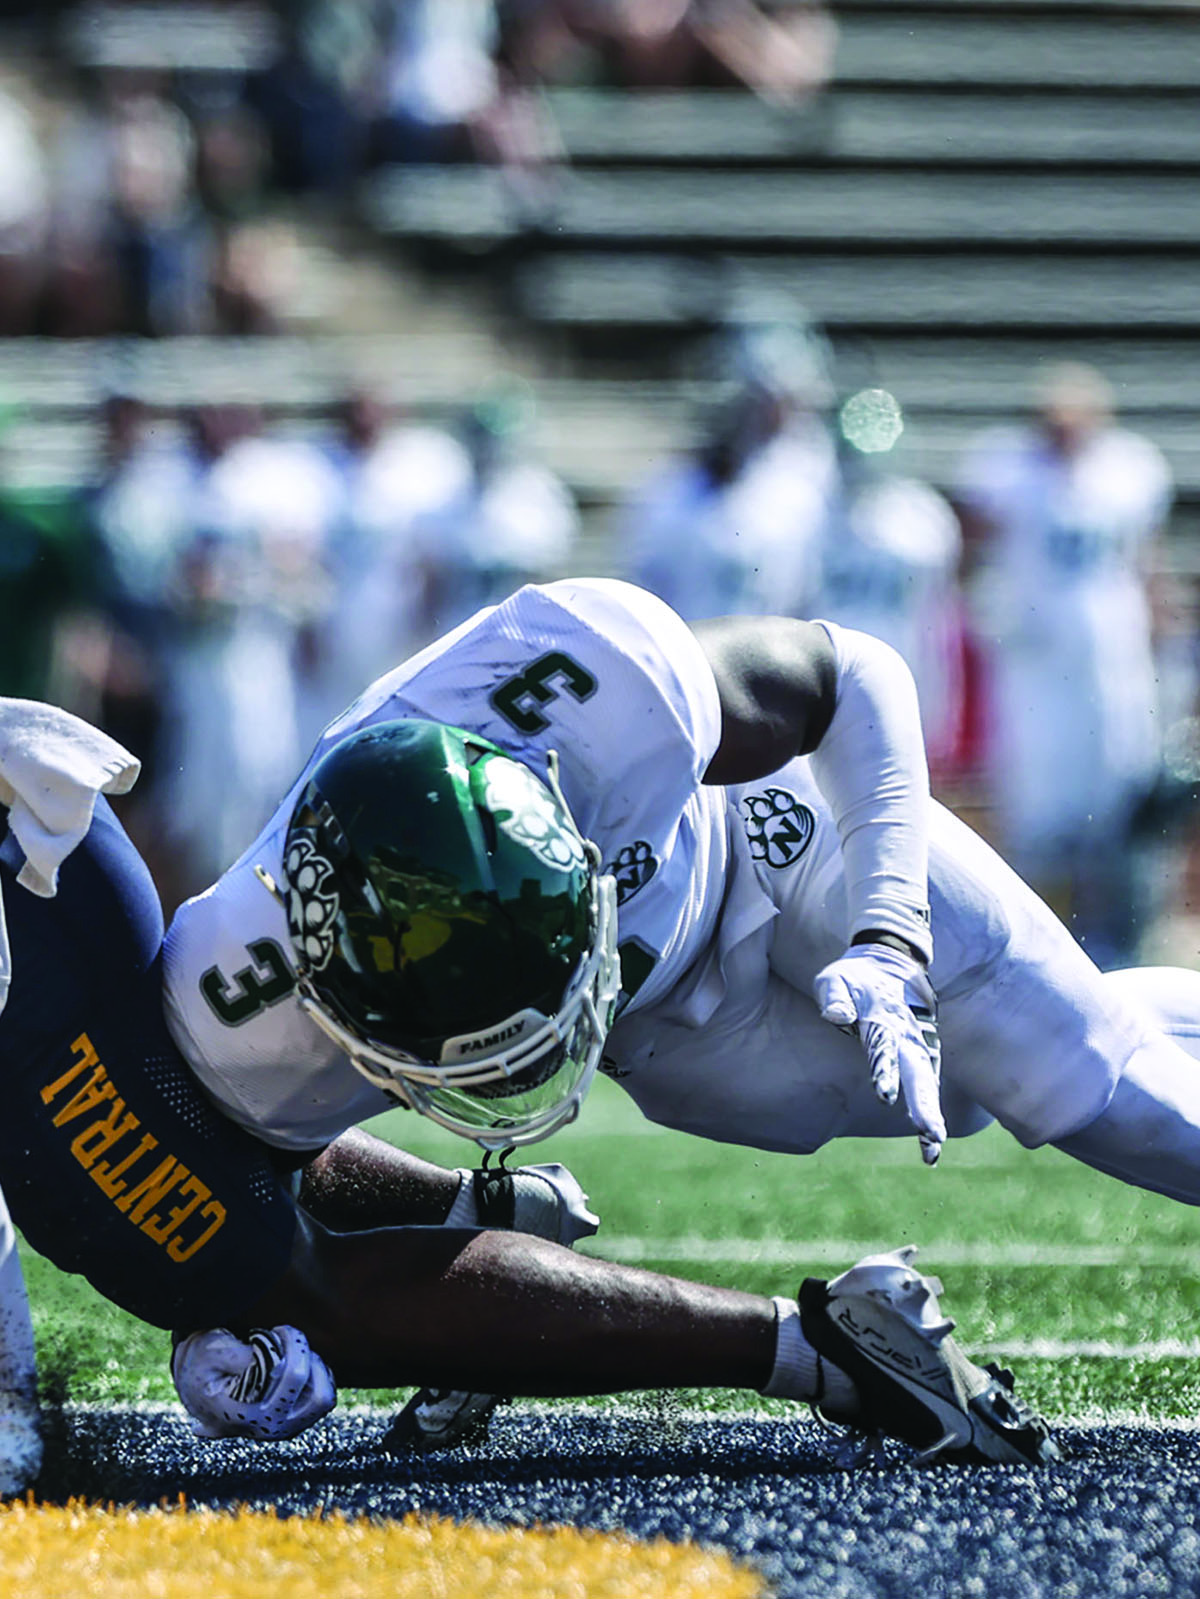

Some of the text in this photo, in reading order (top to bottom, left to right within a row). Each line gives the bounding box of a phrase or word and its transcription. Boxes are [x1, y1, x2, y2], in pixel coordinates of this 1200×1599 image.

[488, 650, 599, 737] 3
[199, 937, 298, 1028] 3
[459, 1020, 526, 1055] FAMILY
[40, 1032, 227, 1262] CENTRAL
